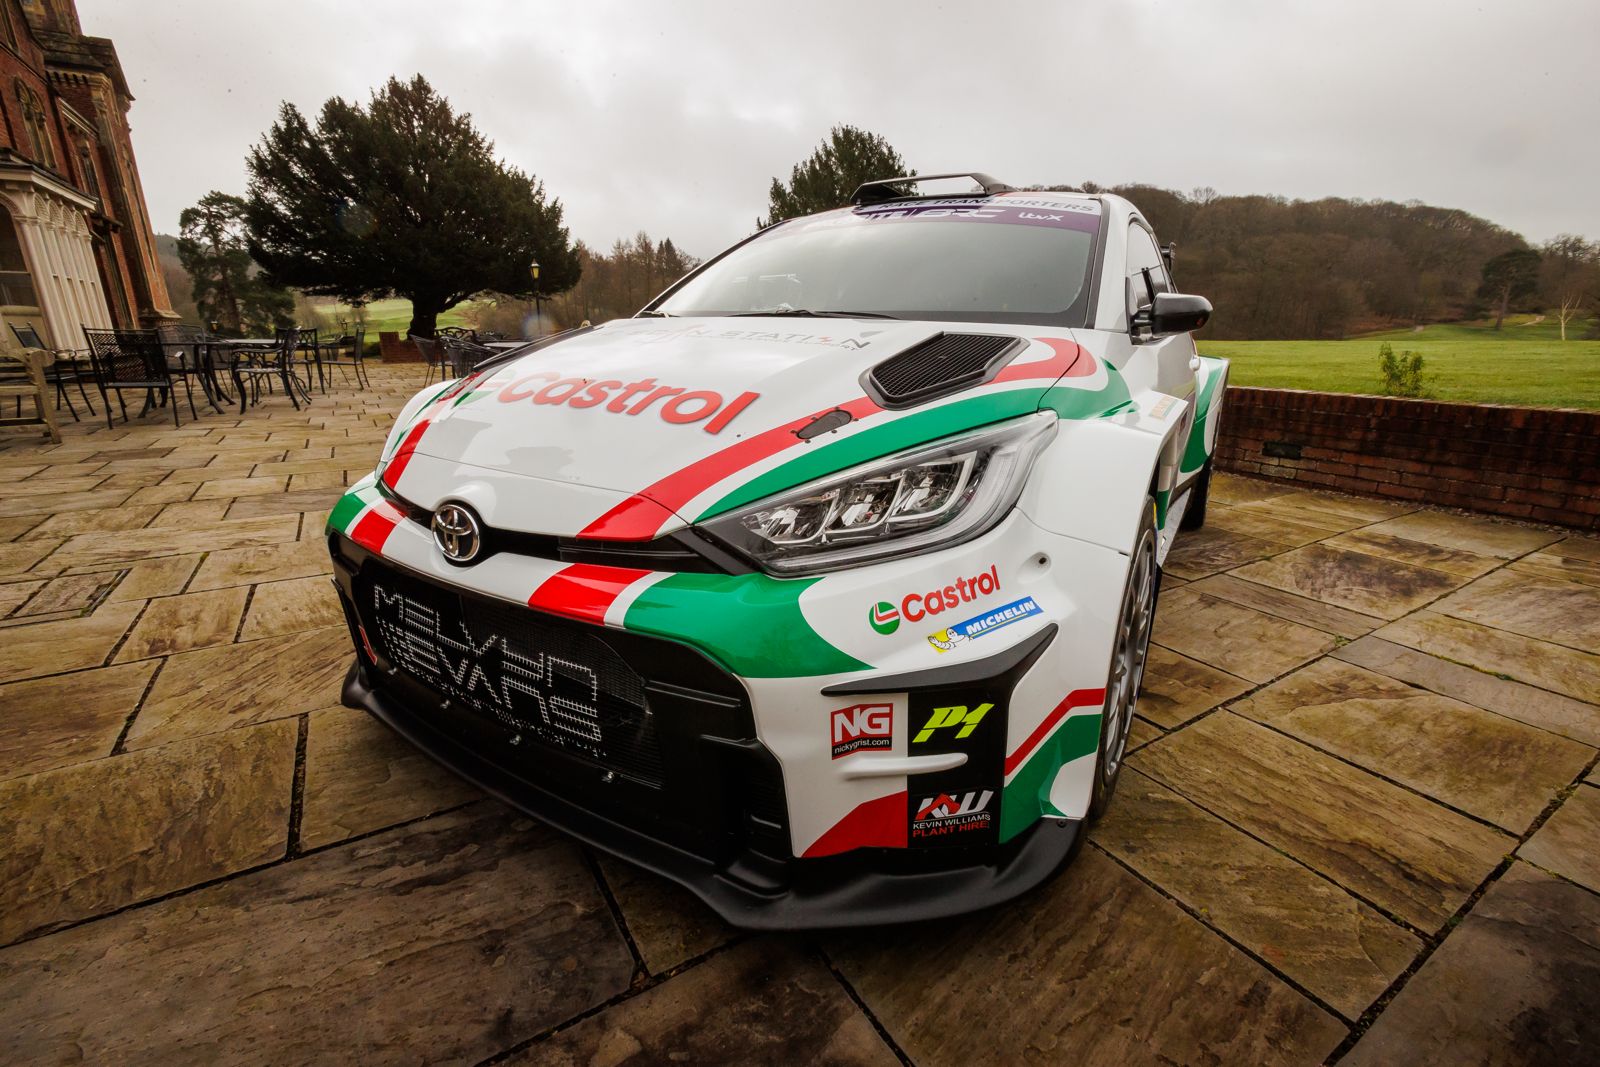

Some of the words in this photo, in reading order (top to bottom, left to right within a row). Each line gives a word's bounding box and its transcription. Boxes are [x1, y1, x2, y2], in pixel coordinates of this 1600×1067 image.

[497, 372, 760, 435] Castrol
[902, 564, 1000, 622] Castrol
[966, 600, 1036, 634] MICHELIN
[834, 706, 890, 743] NG
[912, 703, 995, 743] P1
[834, 738, 890, 754] nickygrist.com
[912, 825, 955, 838] PLANT
[959, 820, 989, 832] HIRE
[913, 821, 942, 830] KEVIN
[945, 814, 991, 826] WILLIAMS
